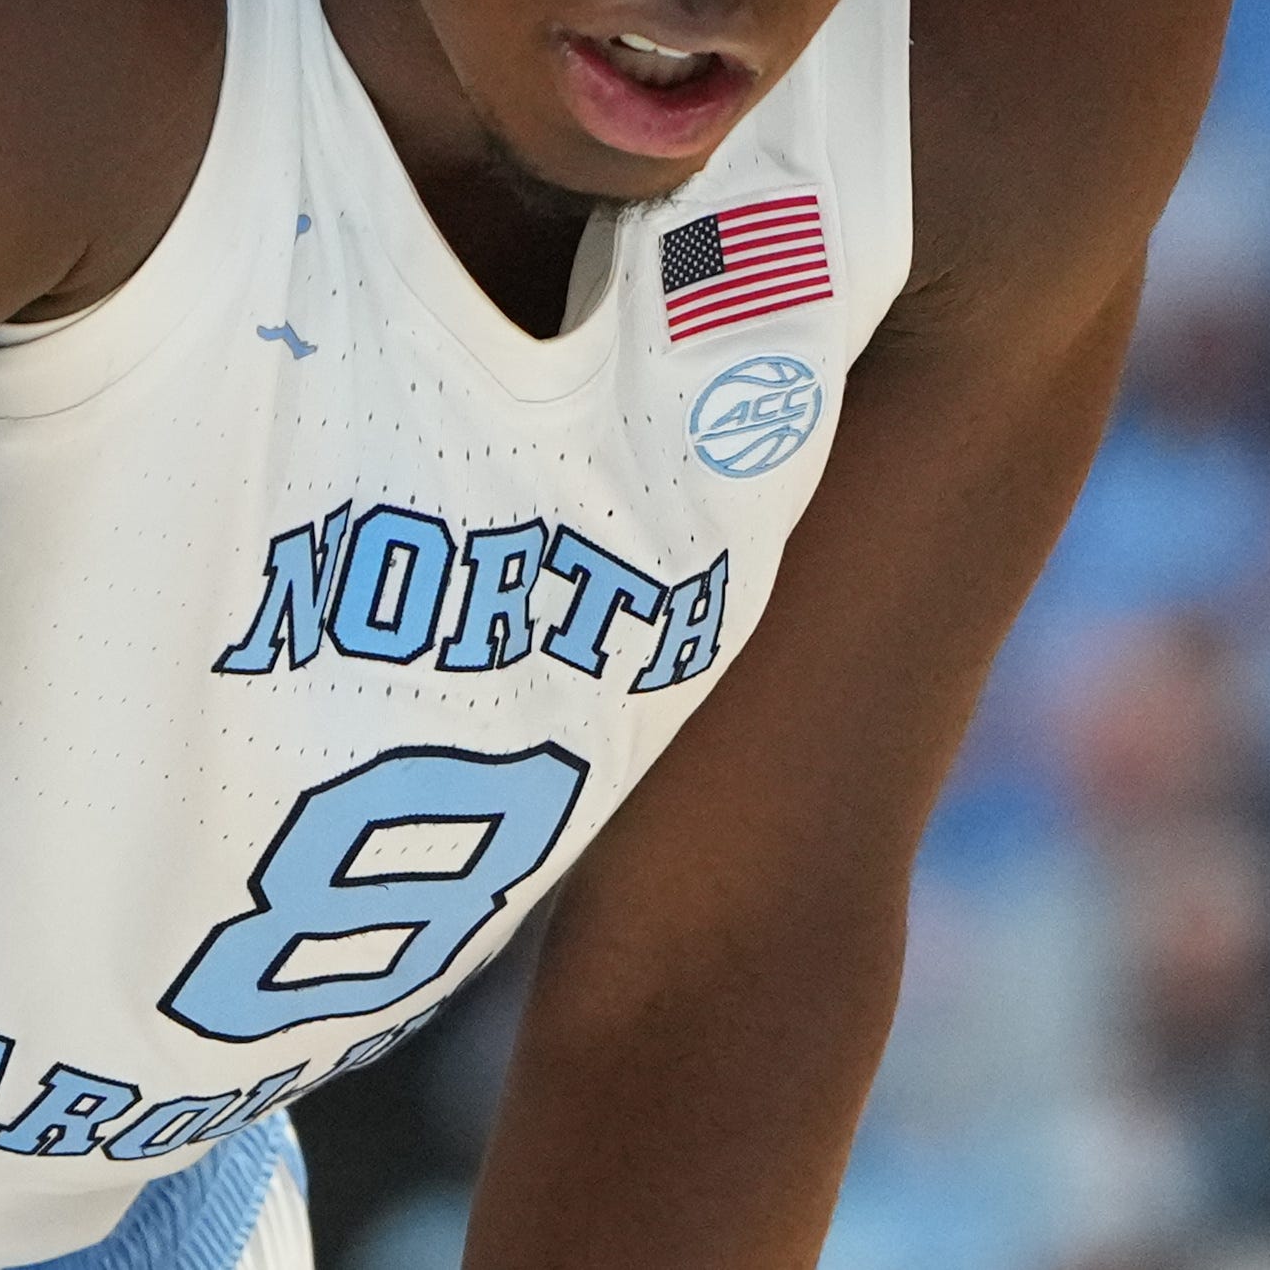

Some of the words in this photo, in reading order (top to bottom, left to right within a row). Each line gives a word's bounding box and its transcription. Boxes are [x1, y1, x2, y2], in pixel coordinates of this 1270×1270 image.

[710, 381, 817, 429] ACC
[211, 498, 730, 695] NORTH
[157, 740, 591, 1043] 8
